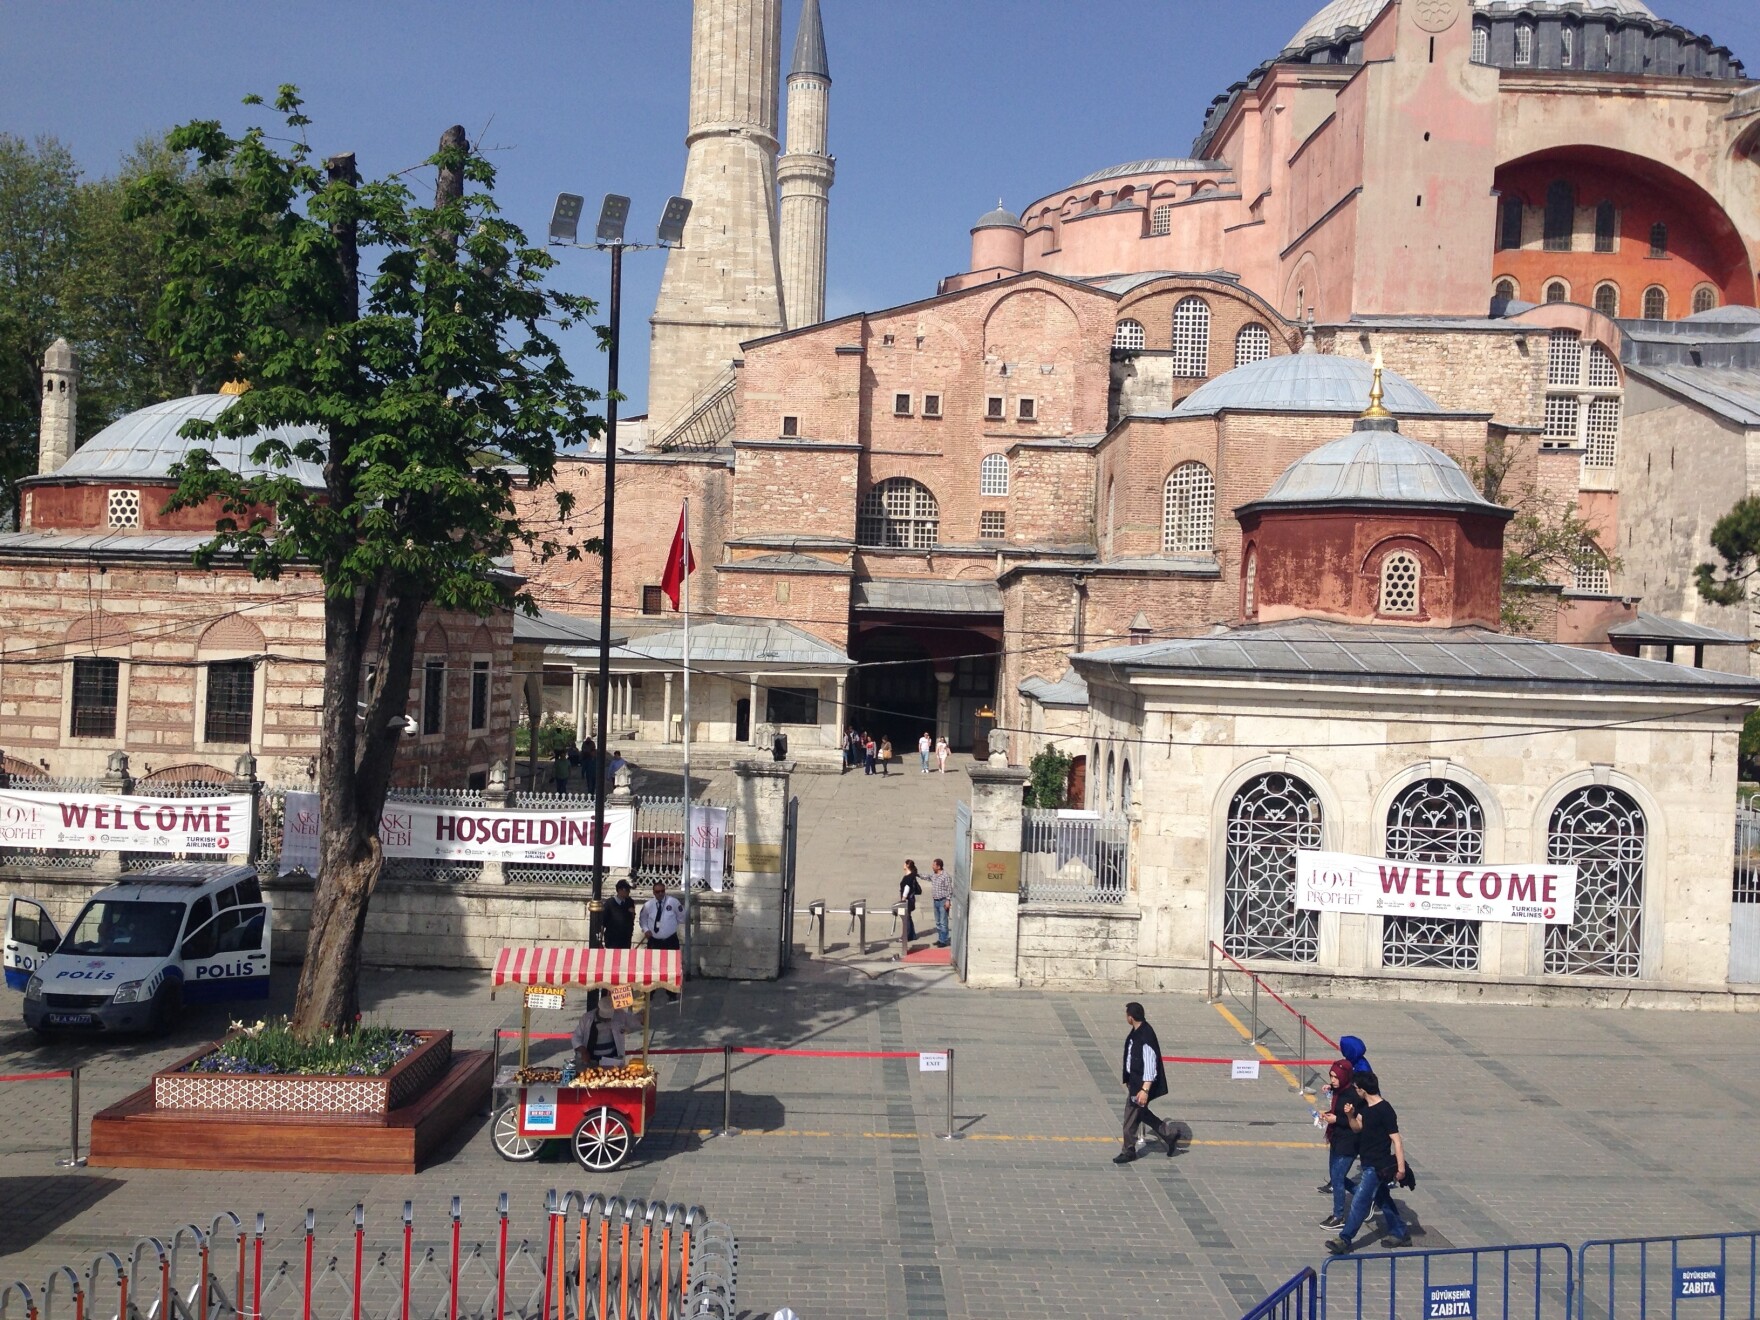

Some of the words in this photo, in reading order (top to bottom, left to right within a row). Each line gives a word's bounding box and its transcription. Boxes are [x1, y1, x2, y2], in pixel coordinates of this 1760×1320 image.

[59, 802, 231, 833] WELCOME
[0, 827, 45, 841] ROPHET
[436, 815, 612, 848] HOŞGELDİNİZ
[987, 872, 1004, 880] EXIT
[1379, 866, 1558, 903] WELCOME
[1307, 890, 1362, 906] PROPHET
[1511, 911, 1542, 919] AIRLINES
[15, 954, 46, 971] POLİ
[196, 960, 254, 978] POLİS
[56, 969, 115, 980] POLİS
[528, 986, 565, 996] KESTANE
[1683, 1270, 1716, 1280] BÜYÜKŞEHİR
[1682, 1281, 1716, 1294] ZABITA
[1431, 1289, 1471, 1302] BÜYÜKŞEHİR
[1431, 1302, 1471, 1317] ZABITA
